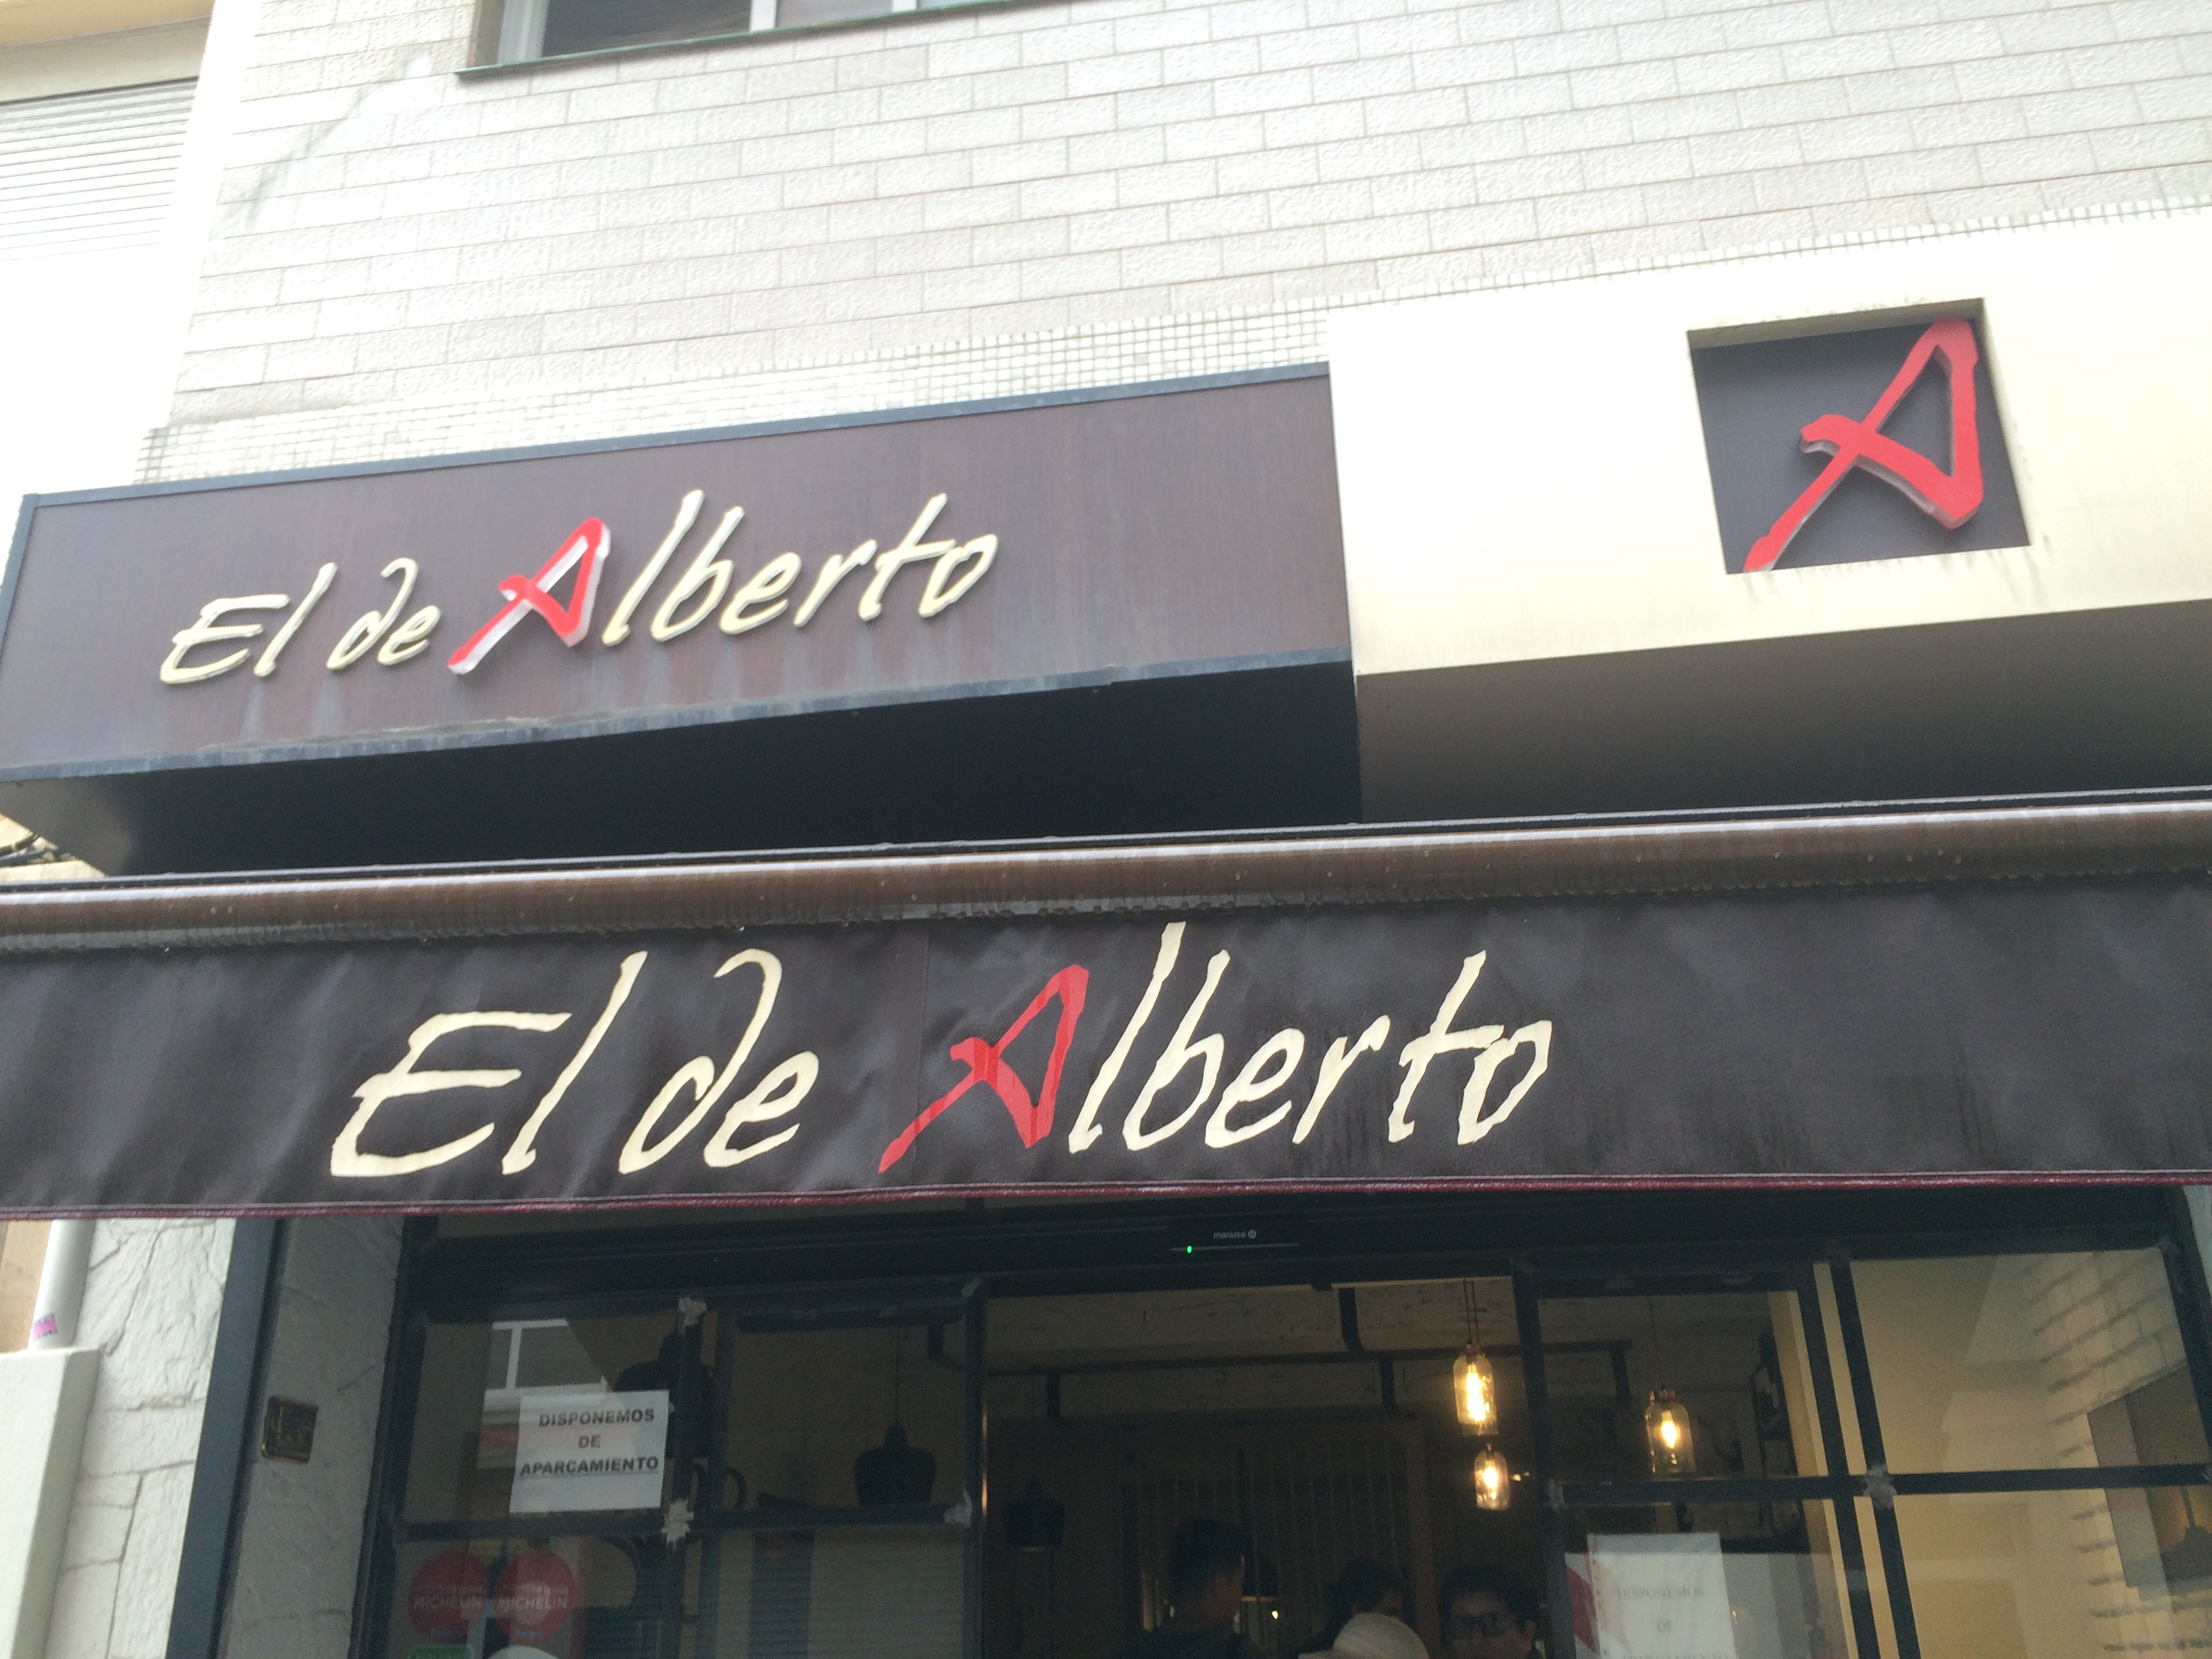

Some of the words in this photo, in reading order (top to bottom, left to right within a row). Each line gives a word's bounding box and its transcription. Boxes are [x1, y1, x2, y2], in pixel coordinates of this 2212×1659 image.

[1742, 316, 1984, 571] A
[160, 562, 337, 684] El
[326, 557, 441, 670] de
[447, 489, 998, 675] Alberto
[330, 951, 648, 1177] El
[619, 949, 819, 1174] de
[878, 921, 1552, 1174] Alberto
[539, 1408, 655, 1427] DISPONEMOS
[577, 1433, 601, 1448] DE
[519, 1456, 659, 1476] APARCAMIENTO
[497, 1596, 568, 1610] MICHELIN
